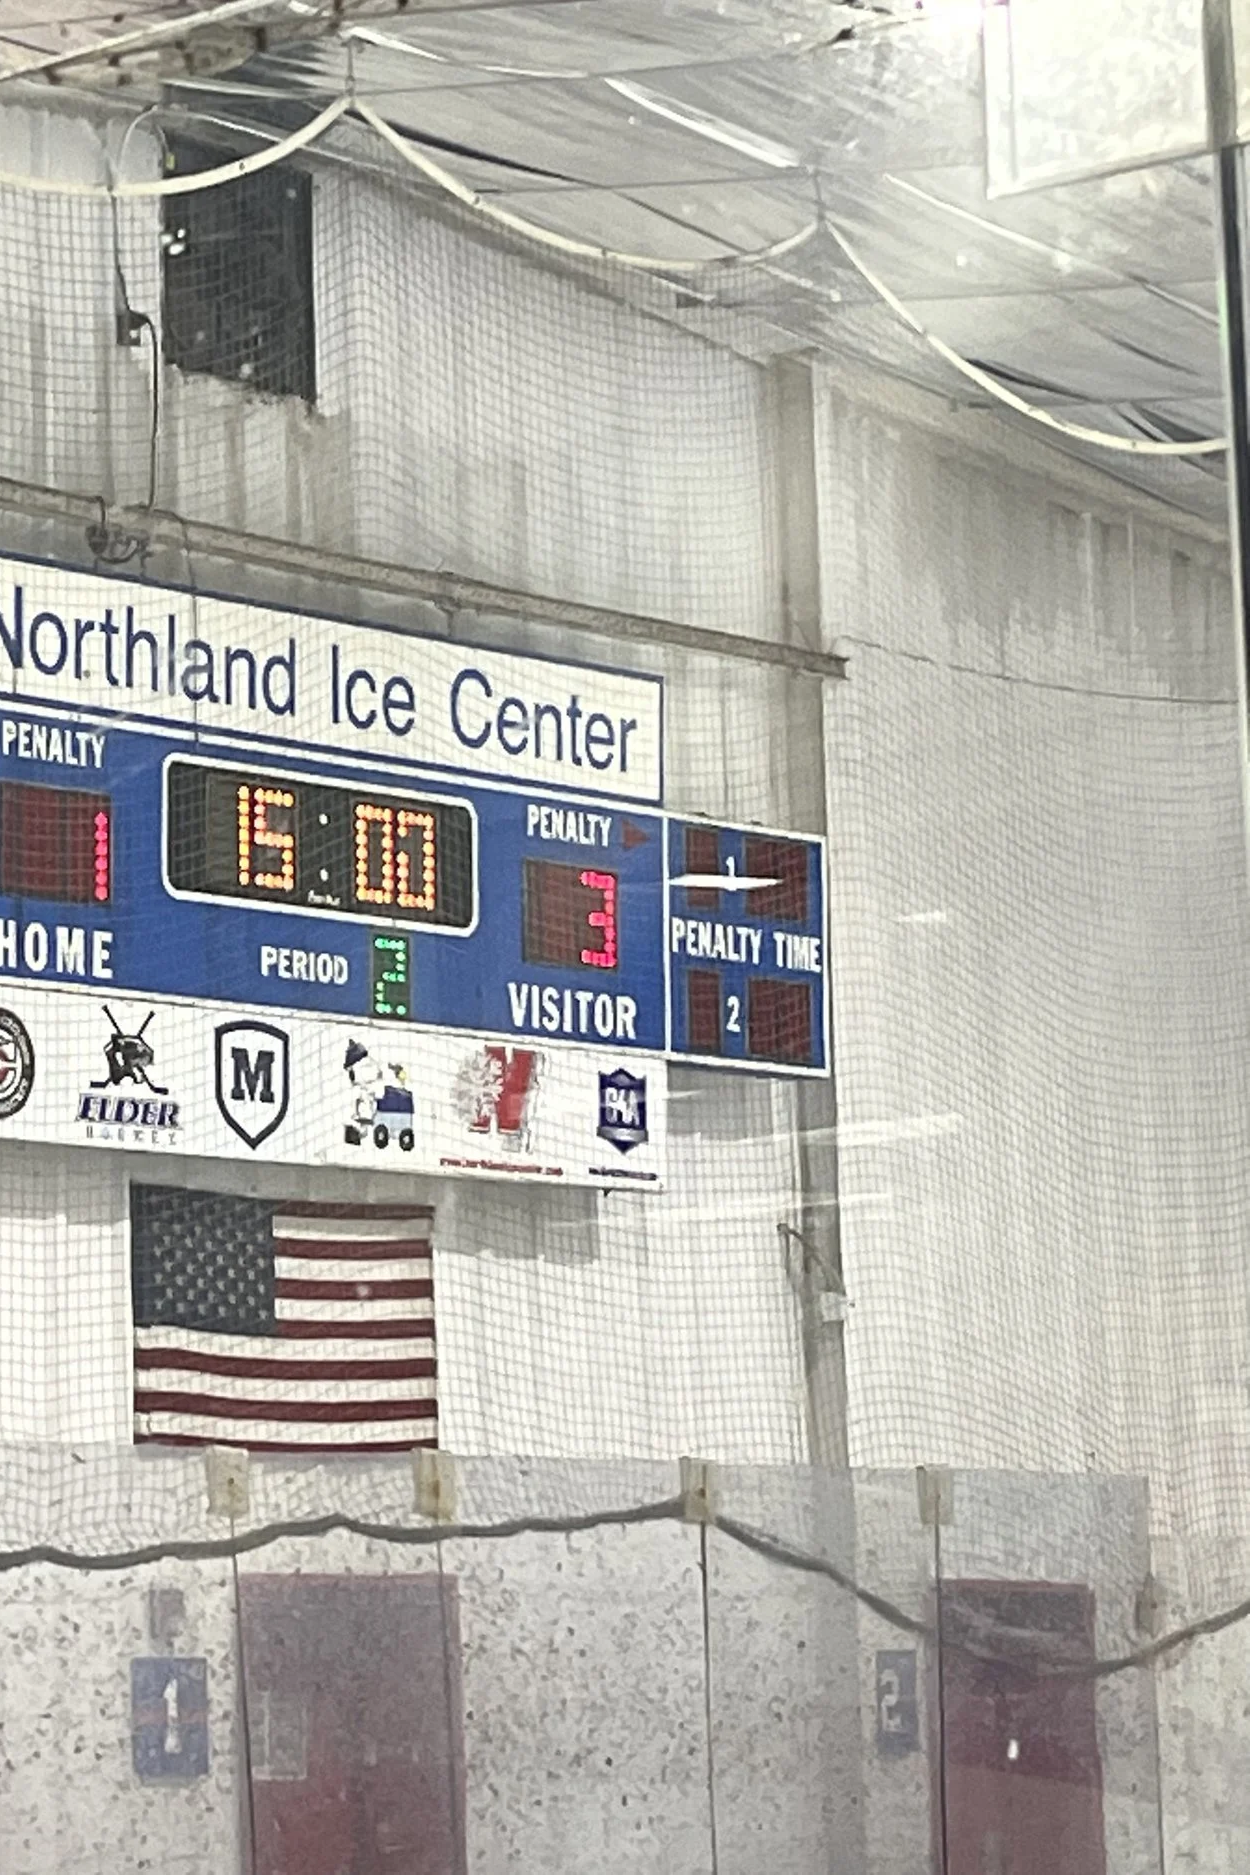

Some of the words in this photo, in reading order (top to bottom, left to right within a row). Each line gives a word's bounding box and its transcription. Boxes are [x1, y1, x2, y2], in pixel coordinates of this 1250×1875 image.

[332, 644, 415, 736] Ice
[450, 669, 637, 772] Center
[2, 720, 106, 768] PENALTY
[527, 804, 612, 848] PENALTY
[94, 811, 109, 900] 1
[579, 871, 617, 968] 3
[671, 917, 762, 965] PENALTY
[773, 931, 822, 973] TIME
[261, 946, 348, 985] PERIOD
[374, 937, 406, 1015] 2
[507, 982, 637, 1040] VISITOR
[726, 996, 741, 1033] 2
[231, 1047, 275, 1103] M
[75, 1094, 182, 1130] ELDER
[162, 1678, 182, 1754] 1
